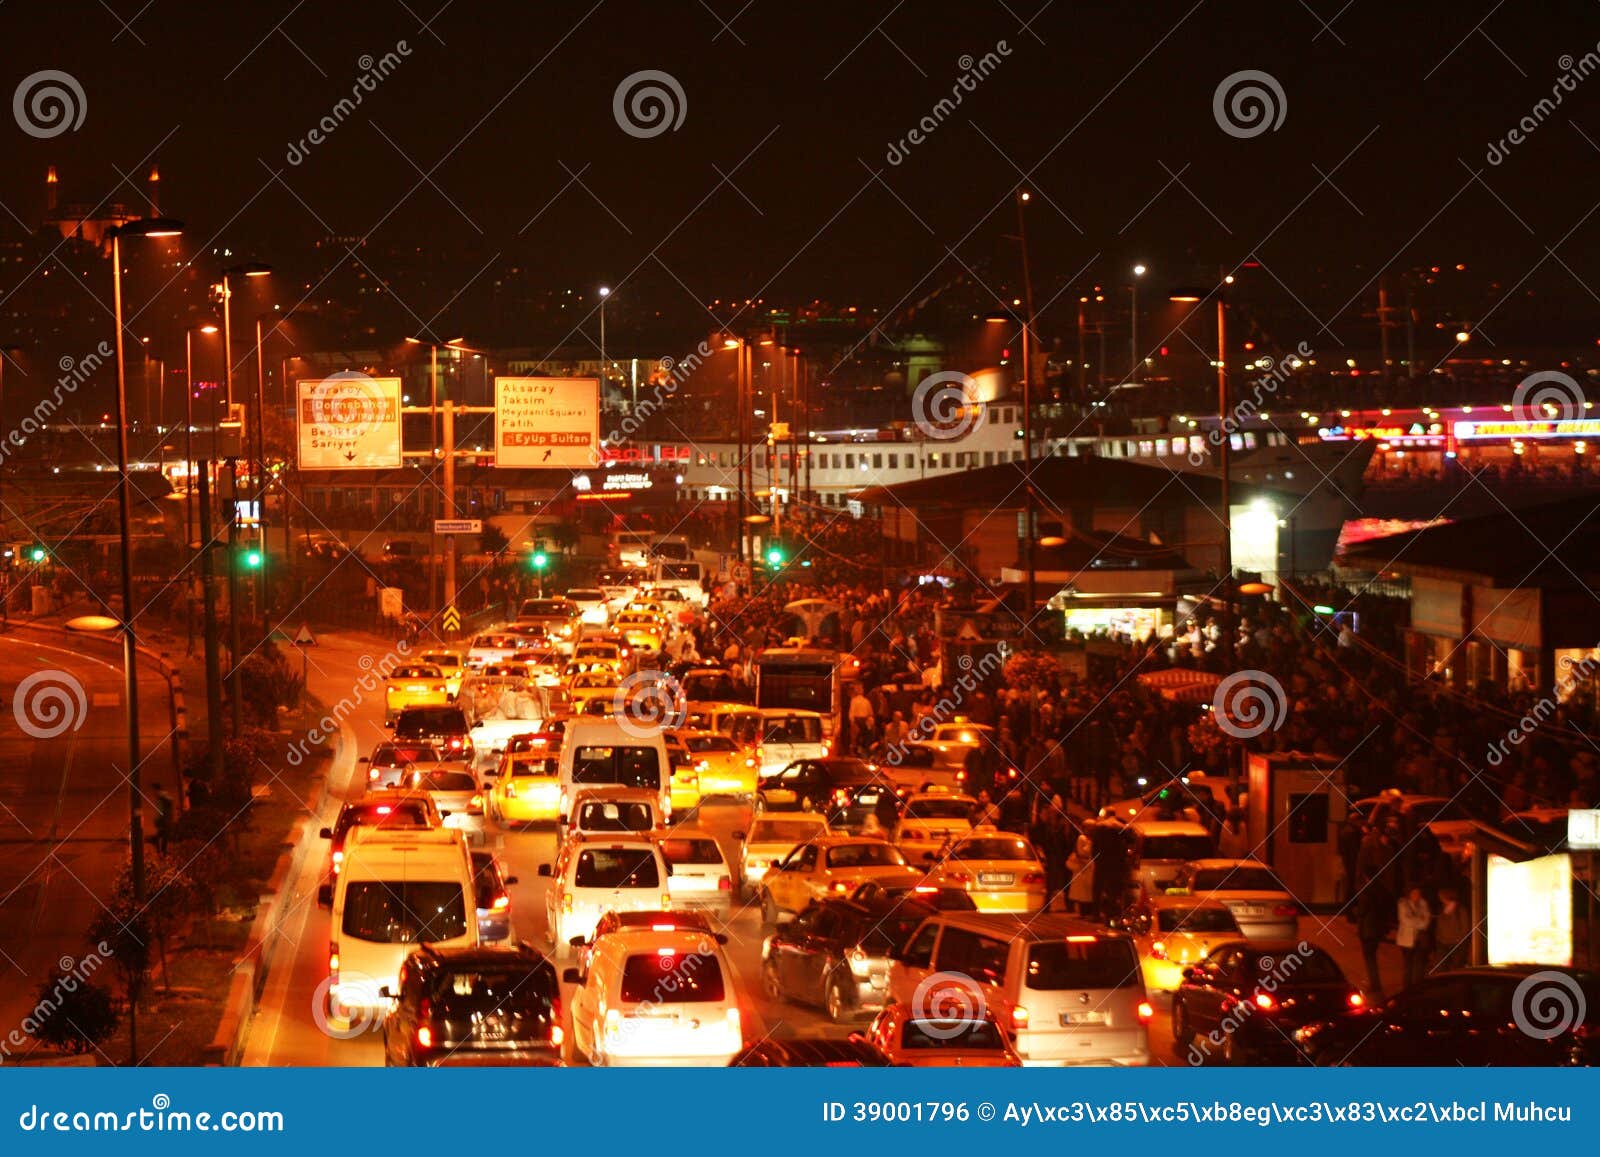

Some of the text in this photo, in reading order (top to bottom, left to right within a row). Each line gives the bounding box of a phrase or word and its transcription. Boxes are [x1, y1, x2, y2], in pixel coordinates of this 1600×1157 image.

[503, 383, 554, 395] Aksaray
[503, 396, 545, 405] Taksim
[502, 419, 534, 428] Fatih
[550, 433, 588, 443] Sultan
